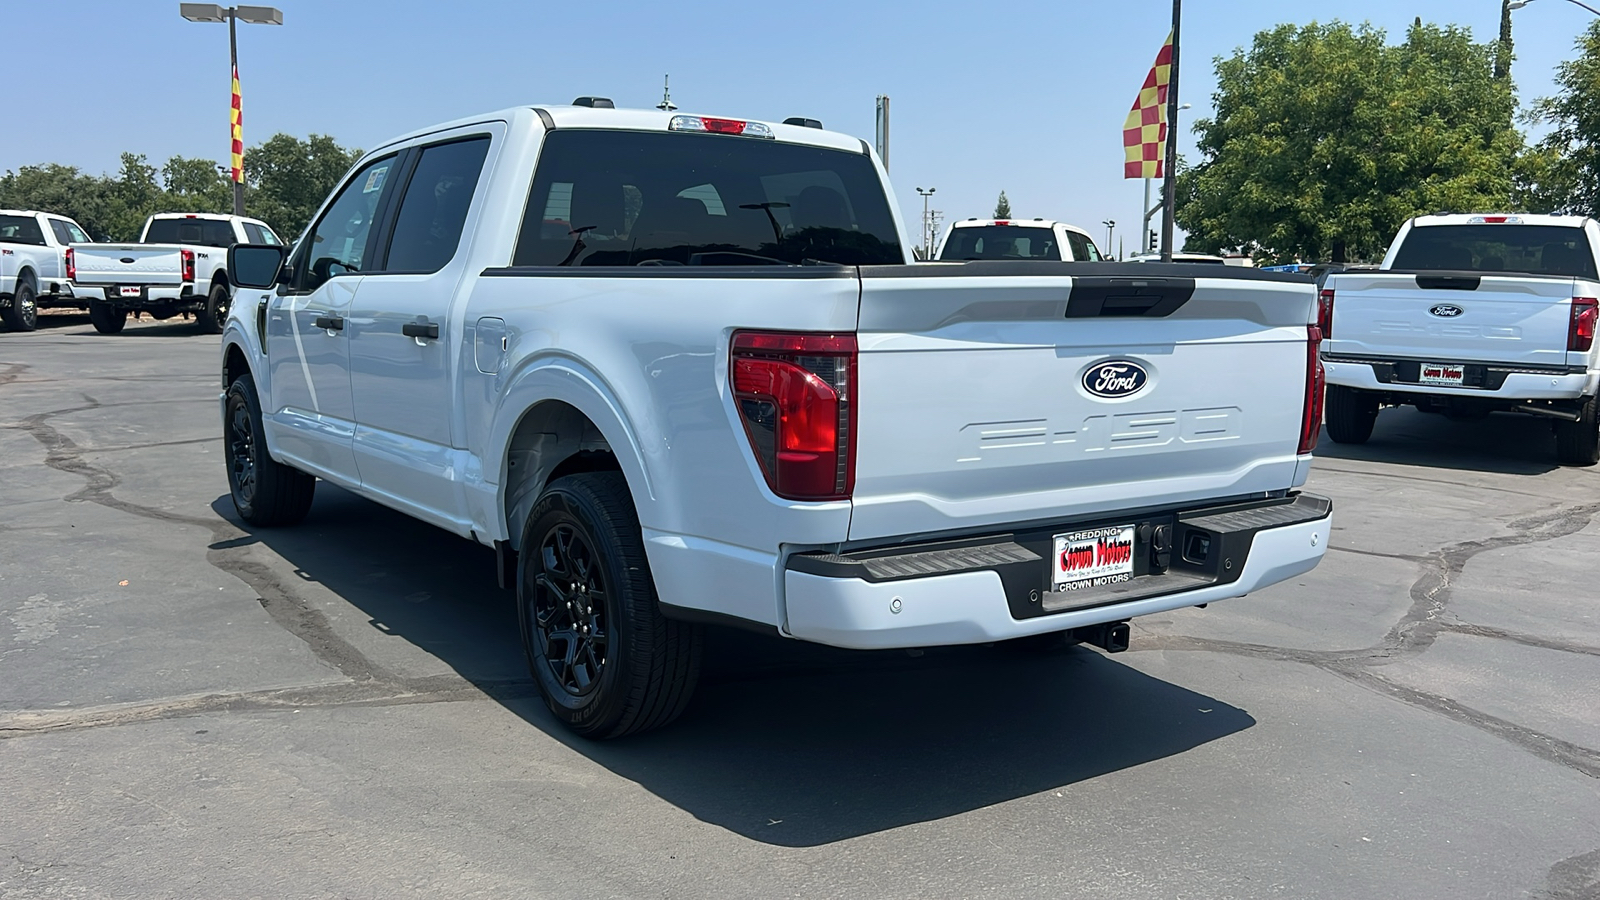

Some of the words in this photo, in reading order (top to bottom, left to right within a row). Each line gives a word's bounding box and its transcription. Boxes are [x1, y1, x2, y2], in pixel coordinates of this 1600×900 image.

[1434, 306, 1458, 316] Ford
[1369, 319, 1523, 341] F-150
[1094, 365, 1137, 392] Ford
[956, 405, 1243, 463] F-150
[1074, 528, 1117, 540] REDDING
[1060, 542, 1093, 572] Crown
[1097, 537, 1131, 567] Motors
[1059, 579, 1091, 592] CROWN
[1093, 574, 1129, 586] MOTORS
